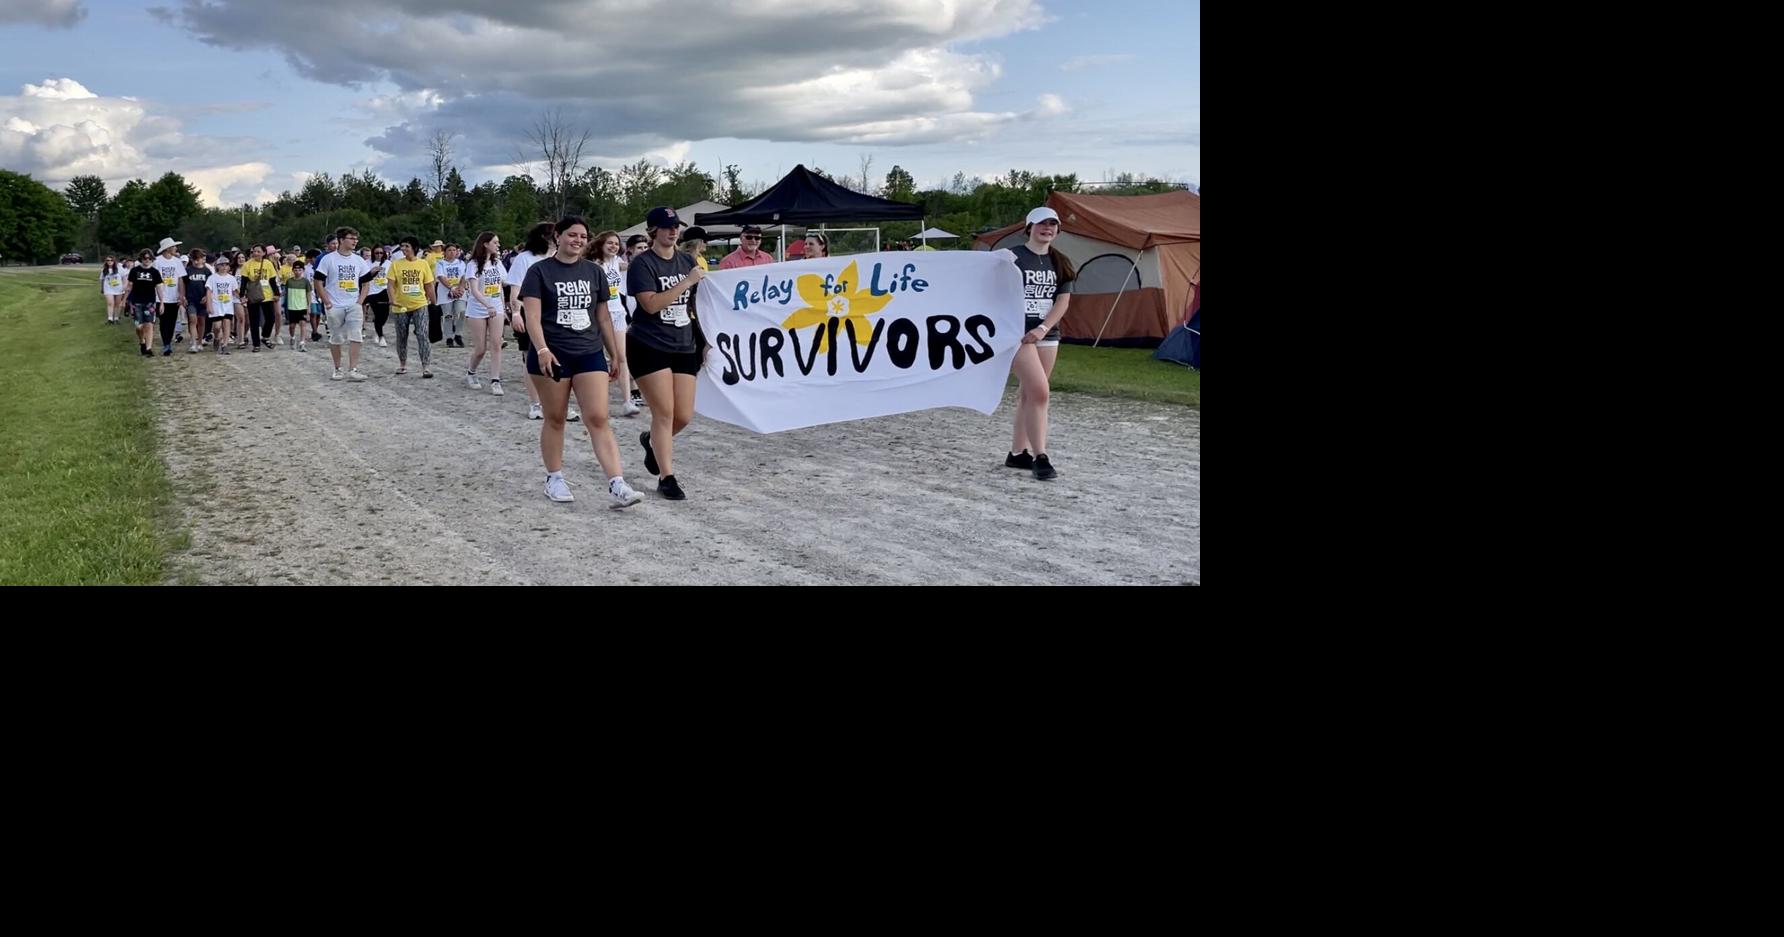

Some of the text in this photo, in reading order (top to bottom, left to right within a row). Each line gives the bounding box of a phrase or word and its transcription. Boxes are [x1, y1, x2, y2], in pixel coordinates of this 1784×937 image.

[732, 262, 929, 310] Relay for Life
[716, 314, 996, 386] SURVIVORS
